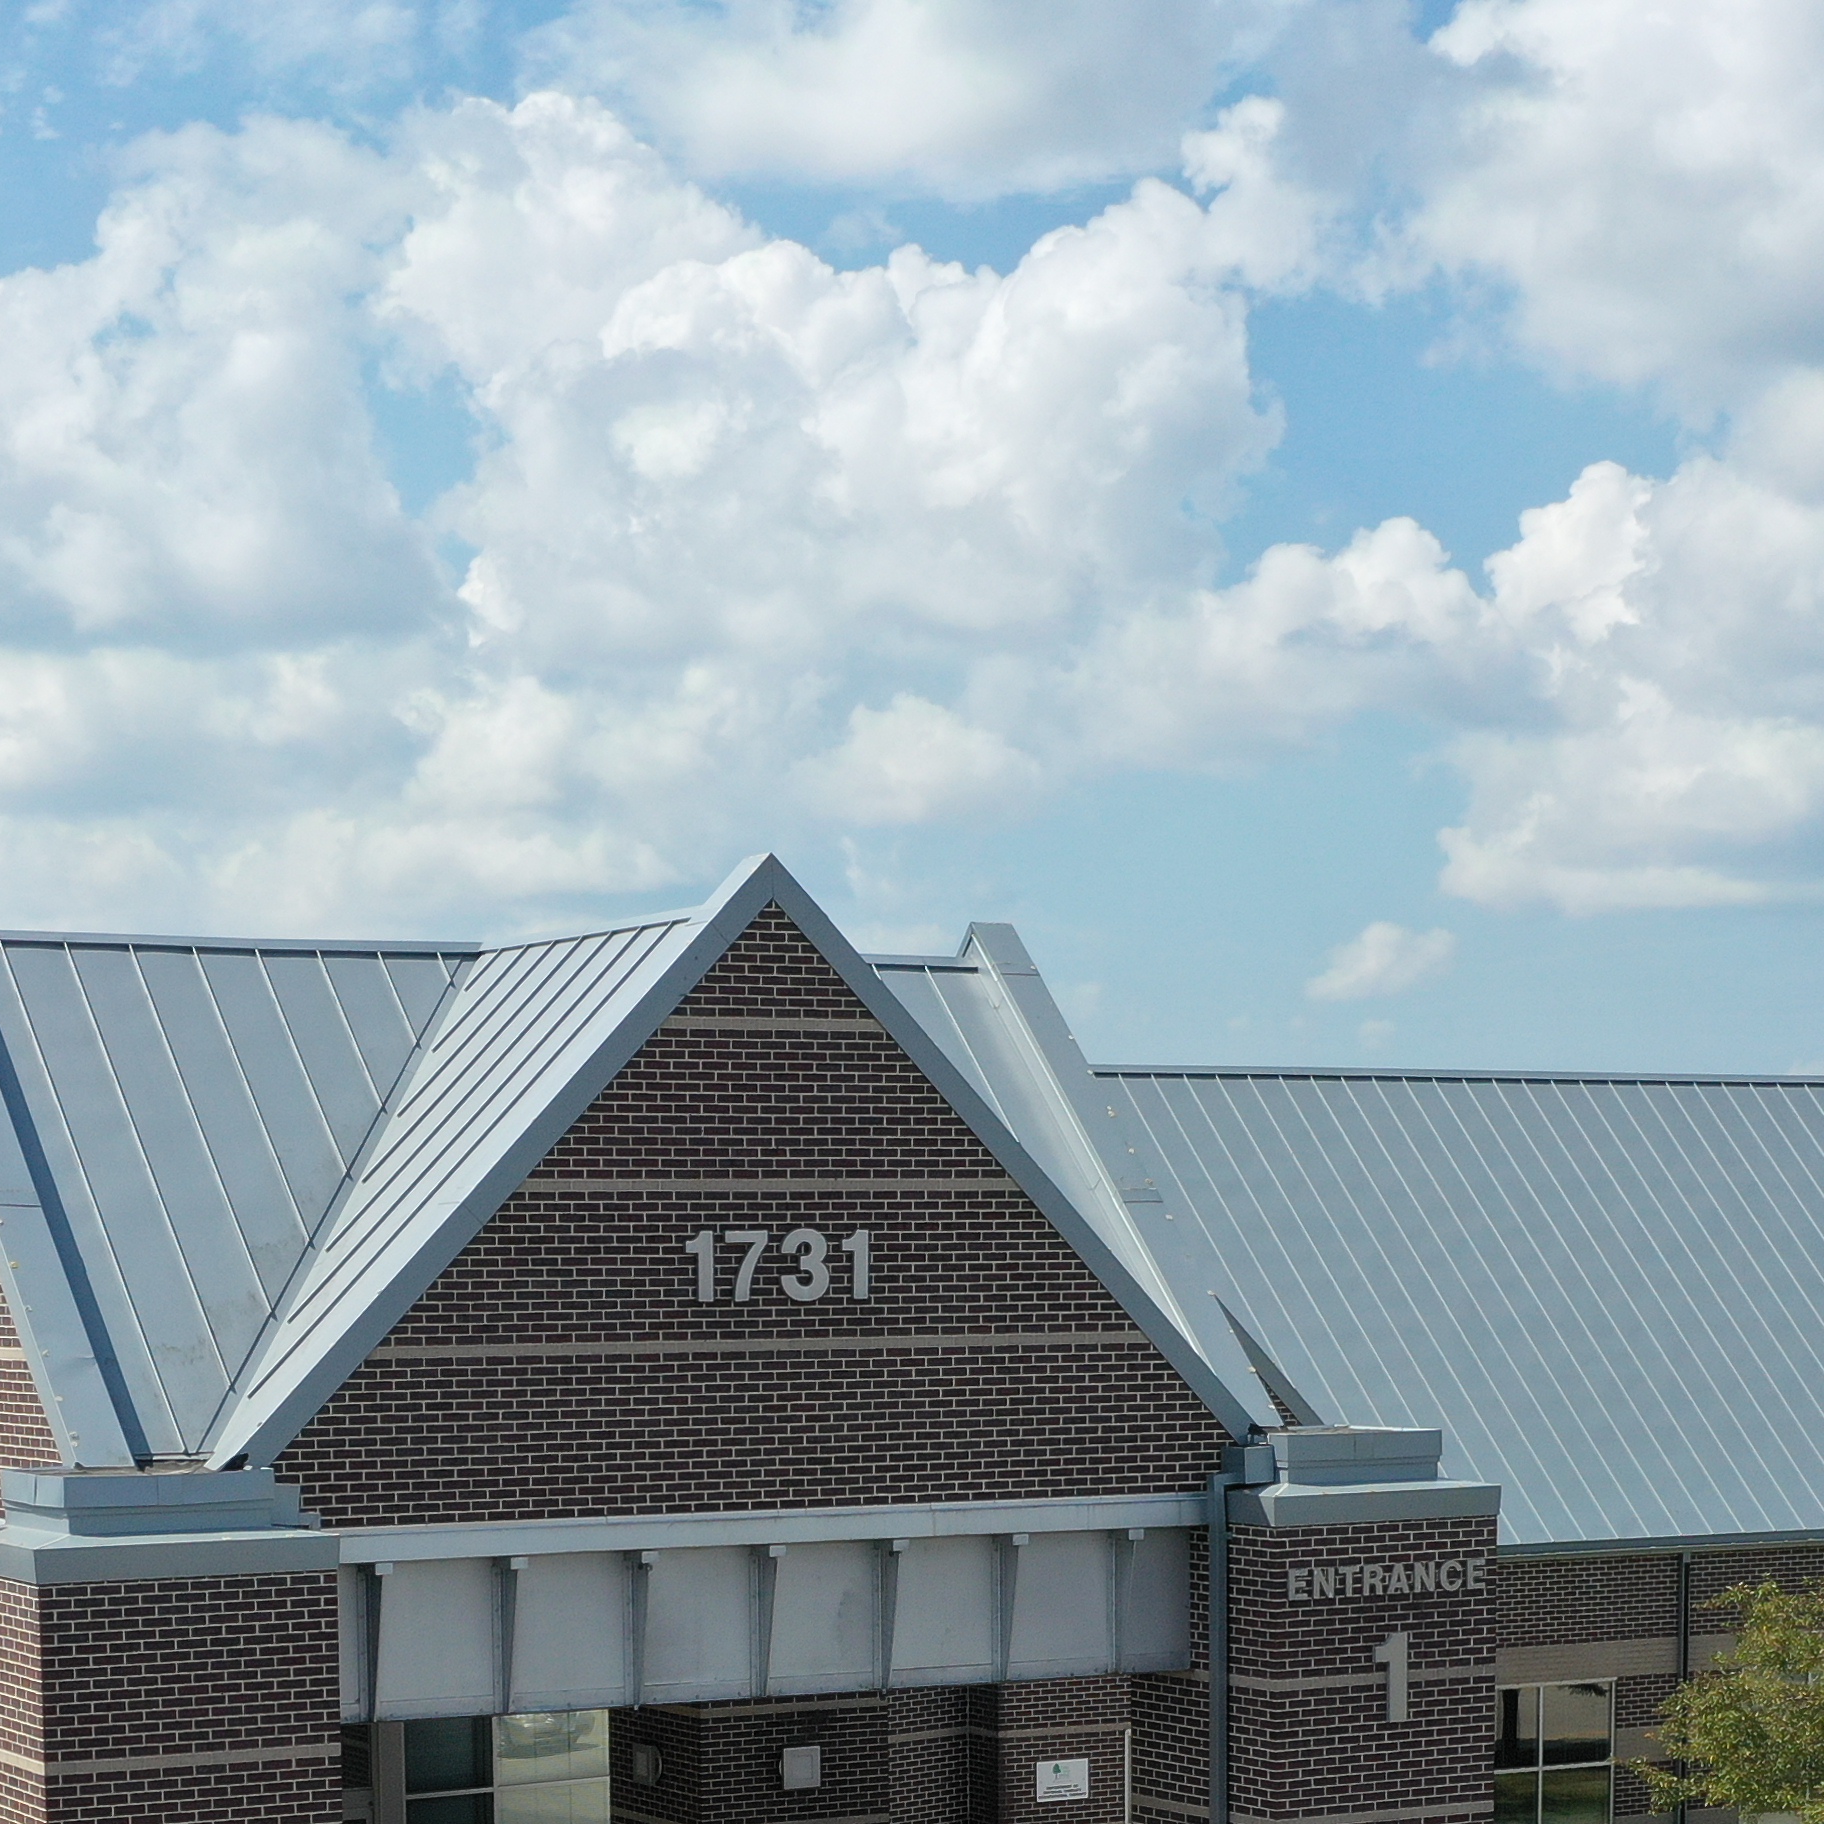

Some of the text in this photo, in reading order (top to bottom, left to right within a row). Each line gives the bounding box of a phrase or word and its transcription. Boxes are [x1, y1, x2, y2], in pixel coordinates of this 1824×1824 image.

[685, 1228, 869, 1302] 1731
[1287, 1557, 1486, 1601] ENTRANCE
[1373, 1631, 1409, 1723] 1
